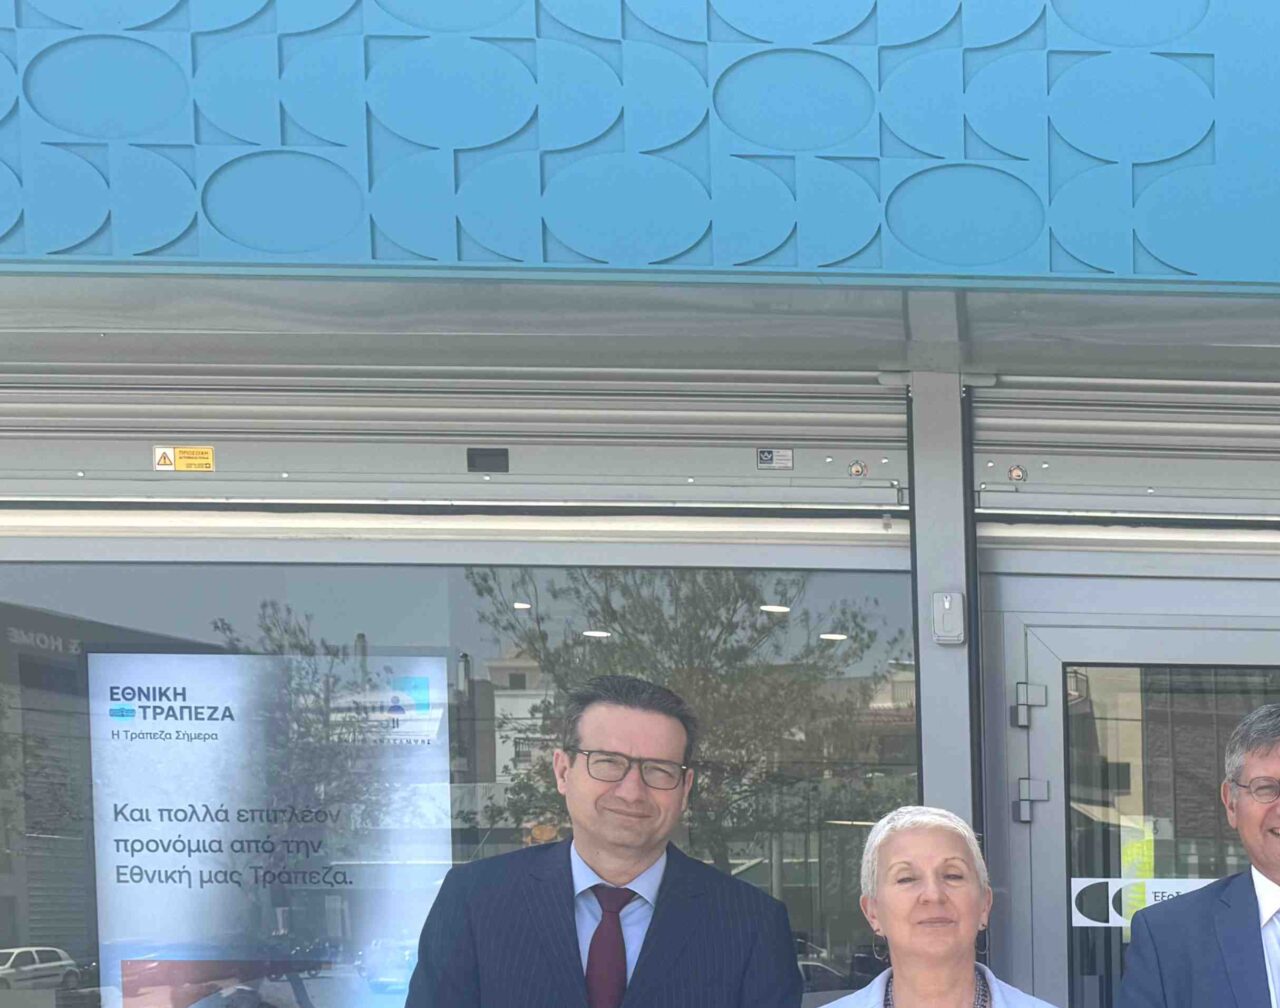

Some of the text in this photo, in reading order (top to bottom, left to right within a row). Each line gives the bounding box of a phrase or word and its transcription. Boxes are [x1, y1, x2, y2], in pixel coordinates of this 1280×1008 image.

[109, 686, 187, 702] ΕΘΝΙΚΗ
[138, 705, 235, 721] ΤΡΑΠΕΖΑ
[111, 730, 218, 742] Η Τράπεζα Σήμερα
[114, 803, 341, 823] Και πολλά επιπλέον
[113, 834, 323, 858] προνόμια από την
[116, 865, 353, 889] Εθνική μας Τράπεζα.
